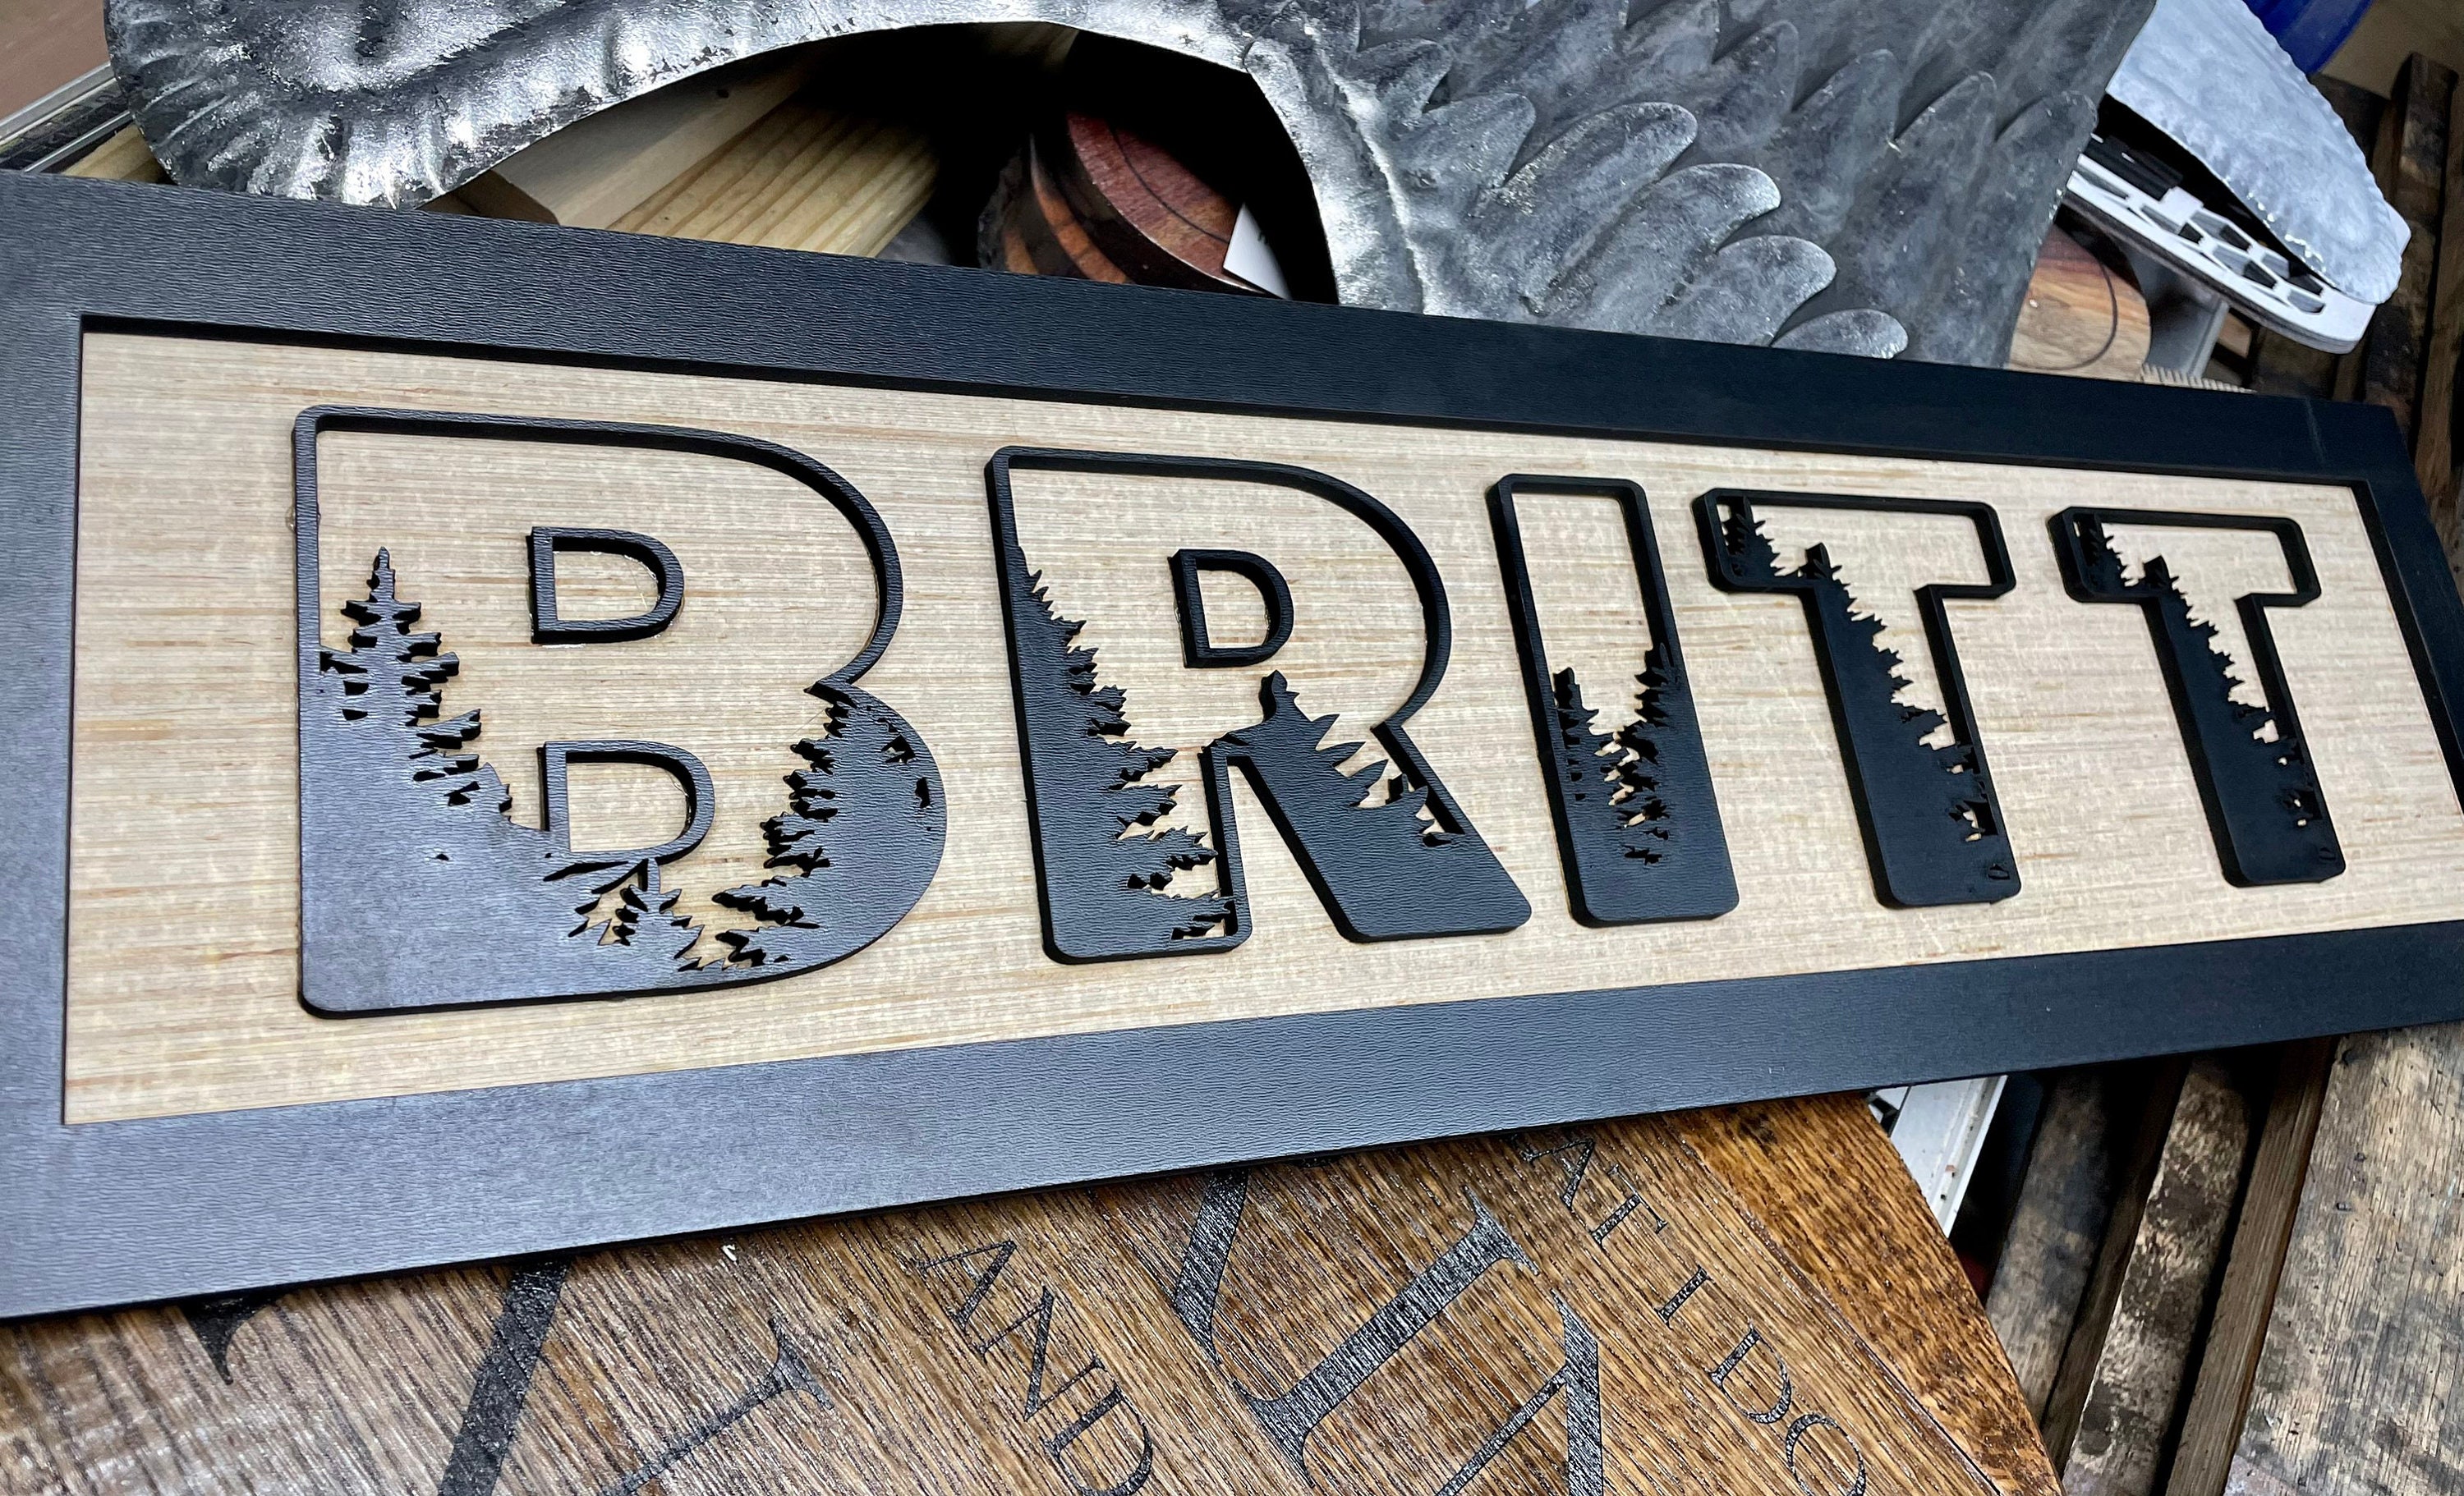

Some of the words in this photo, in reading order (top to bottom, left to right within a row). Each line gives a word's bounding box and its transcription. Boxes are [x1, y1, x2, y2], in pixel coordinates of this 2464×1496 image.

[291, 404, 2347, 1019] BRITT
[909, 1238, 1154, 1496] AND
[1505, 1133, 1668, 1248] AT
[1653, 1264, 1717, 1330] I
[1707, 1319, 1866, 1496] DO
